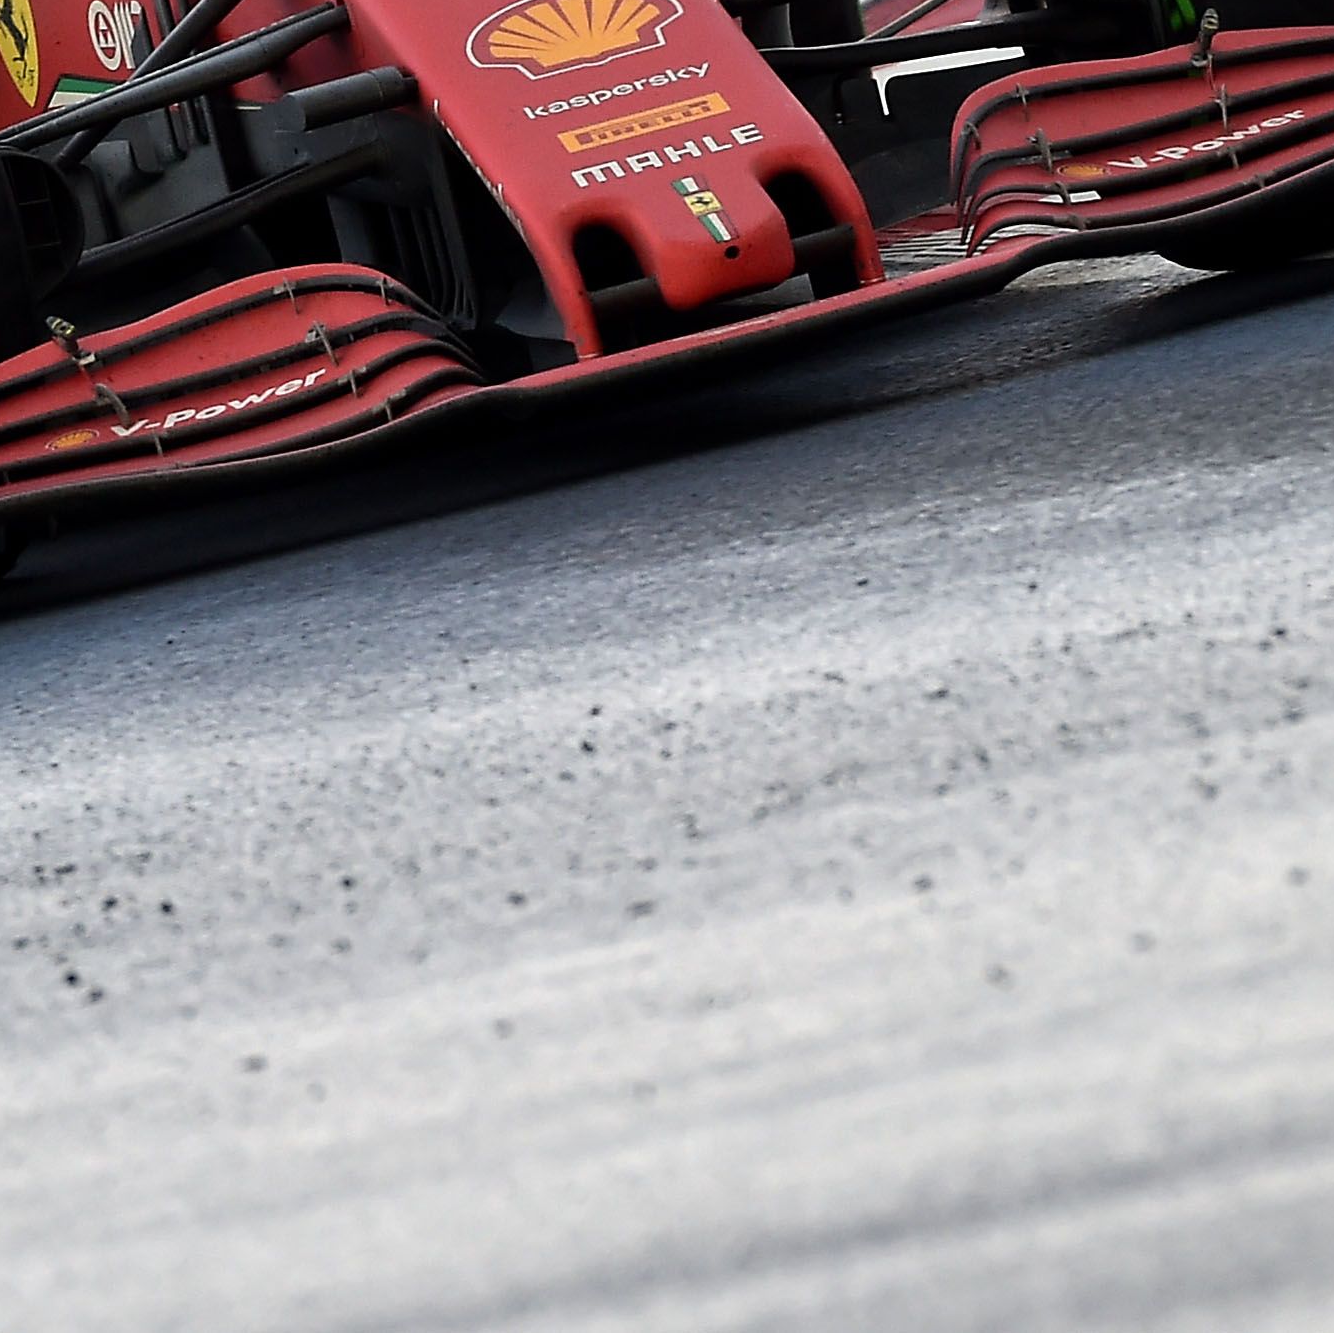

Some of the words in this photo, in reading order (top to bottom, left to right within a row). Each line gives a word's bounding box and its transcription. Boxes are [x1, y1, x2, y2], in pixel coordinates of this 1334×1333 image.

[522, 61, 710, 120] kaspersky
[570, 123, 764, 189] MAHLE
[1107, 109, 1305, 169] V-Power
[110, 368, 327, 437] V-Power
